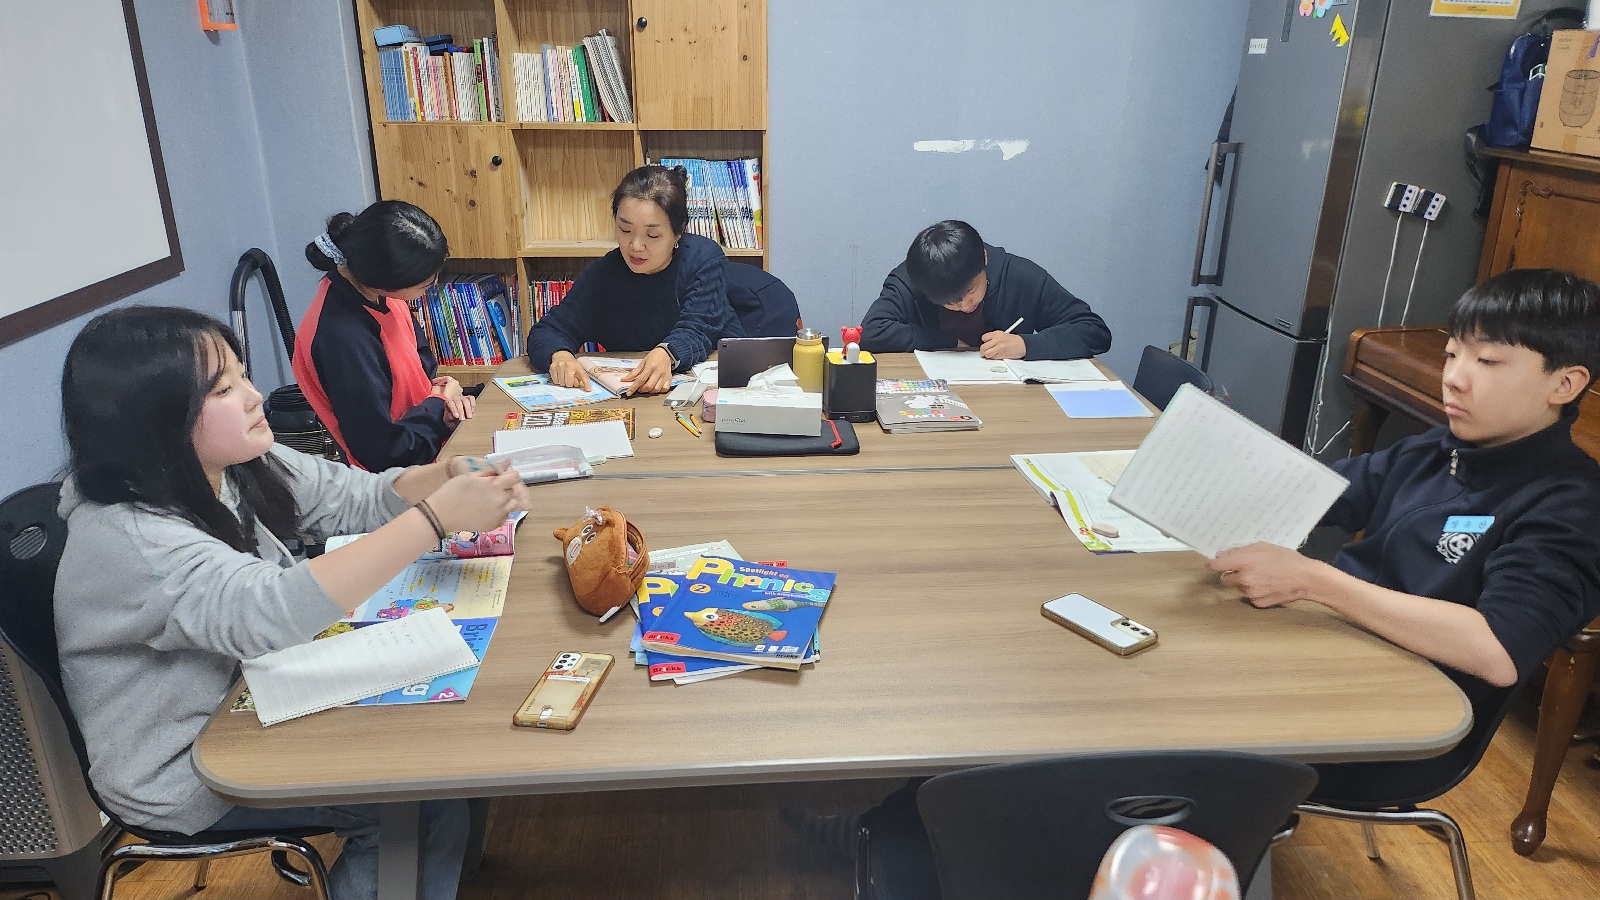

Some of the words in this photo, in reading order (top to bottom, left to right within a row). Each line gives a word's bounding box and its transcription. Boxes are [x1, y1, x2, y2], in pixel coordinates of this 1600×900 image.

[685, 556, 832, 603] Phonics
[739, 566, 778, 576] Spotlight
[694, 583, 707, 593] 2
[464, 624, 488, 652] Bric
